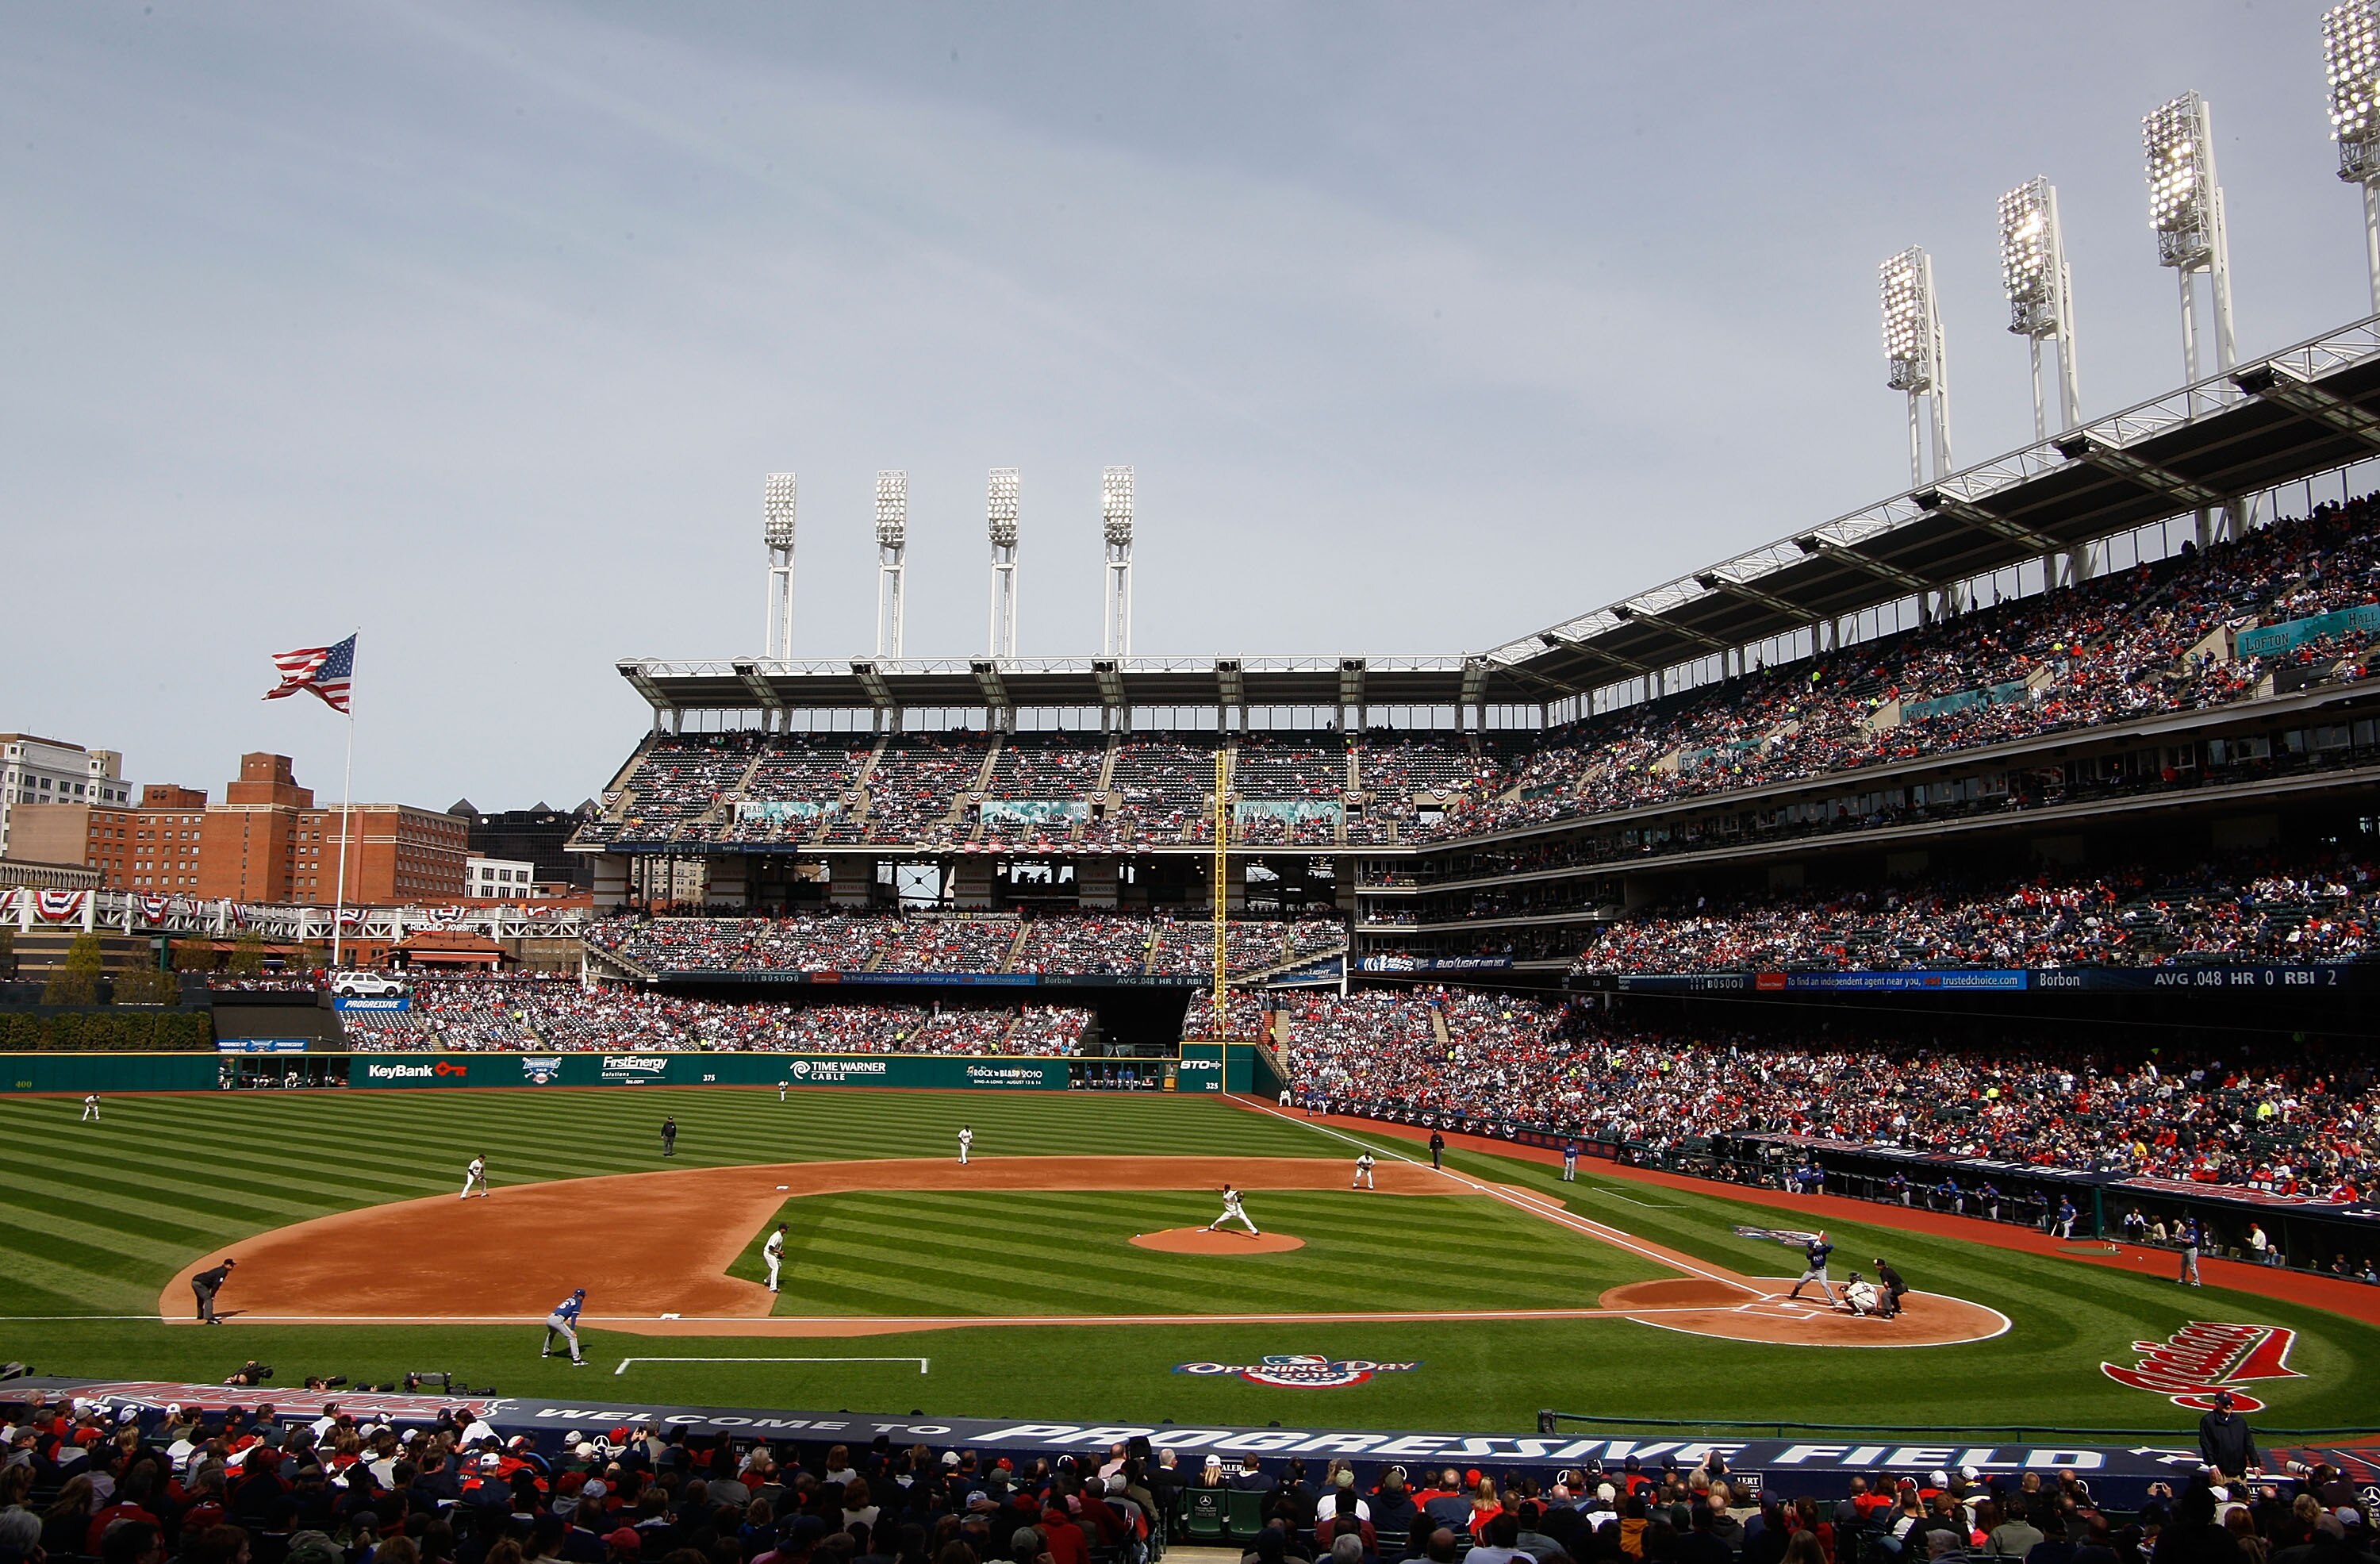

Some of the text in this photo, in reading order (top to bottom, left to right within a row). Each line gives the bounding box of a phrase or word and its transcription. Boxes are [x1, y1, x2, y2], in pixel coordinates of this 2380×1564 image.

[2348, 612, 2378, 626] HALL
[2244, 632, 2290, 651] LOFTON
[740, 805, 767, 813] GRADY
[1063, 805, 1085, 814] CHOO
[1240, 805, 1271, 814] LEMON
[409, 923, 478, 932] RIDGID JOBSITE
[1383, 957, 1414, 971] BUD LIGHT
[1436, 959, 1453, 969] BUD
[1455, 958, 1481, 969] LIGHT
[1177, 977, 1182, 986] 0
[1787, 977, 1795, 986] To
[1797, 976, 1810, 986] find
[1821, 976, 1863, 988] independent
[1864, 978, 1885, 988] agent
[1905, 978, 1921, 988] you,
[1943, 975, 2018, 986] trustedchoice.com
[2040, 972, 2080, 986] Borbon
[2154, 970, 2337, 986] AVG .048 HR 0 RBI 2
[344, 1000, 401, 1009] PROGRESSIVE
[602, 1055, 668, 1070] FirstEnergy
[811, 1061, 886, 1072] TIME WARNER
[1180, 1060, 1211, 1070] STO
[369, 1064, 433, 1079] KeyBank
[973, 1069, 993, 1078] ROCK
[1021, 1070, 1043, 1078] 2010
[1182, 1360, 1415, 1374] OPENING DAY
[2100, 1320, 2309, 1412] Indians
[535, 1408, 2107, 1470] WELCOME TO PROGRESSIVE FIELD
[1737, 1477, 1759, 1485] LERT
